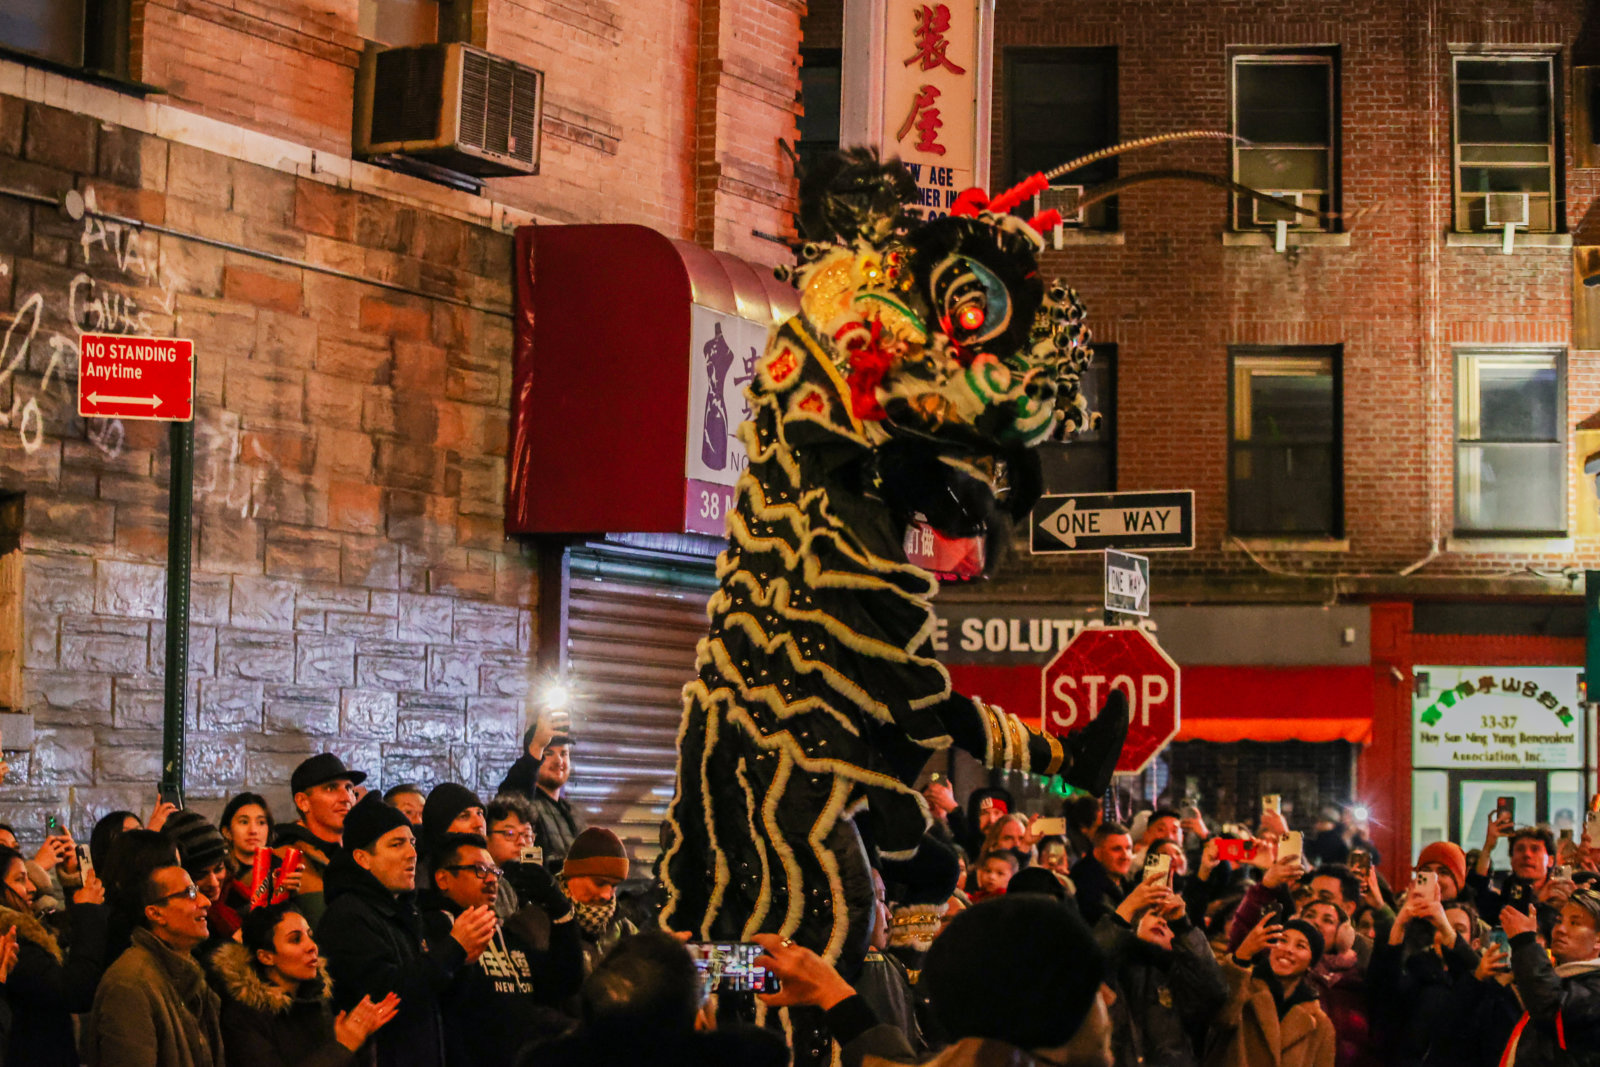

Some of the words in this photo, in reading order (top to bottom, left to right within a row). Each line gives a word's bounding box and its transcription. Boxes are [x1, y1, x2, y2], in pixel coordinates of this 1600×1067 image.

[929, 166, 954, 187] AGE
[86, 342, 105, 358] NO
[109, 344, 177, 363] STANDING
[86, 362, 143, 381] Anytime
[700, 490, 720, 520] 38
[1056, 512, 1101, 535] ONE
[1123, 509, 1171, 532] WAY
[1111, 569, 1124, 593] ONE
[1128, 573, 1142, 596] WAY
[1051, 674, 1169, 727] STOP
[1480, 715, 1518, 729] 33-37
[1519, 732, 1574, 744] Benevolent
[1452, 751, 1521, 764] Association,
[1524, 752, 1546, 763] Inc.
[494, 981, 515, 993] NEW
